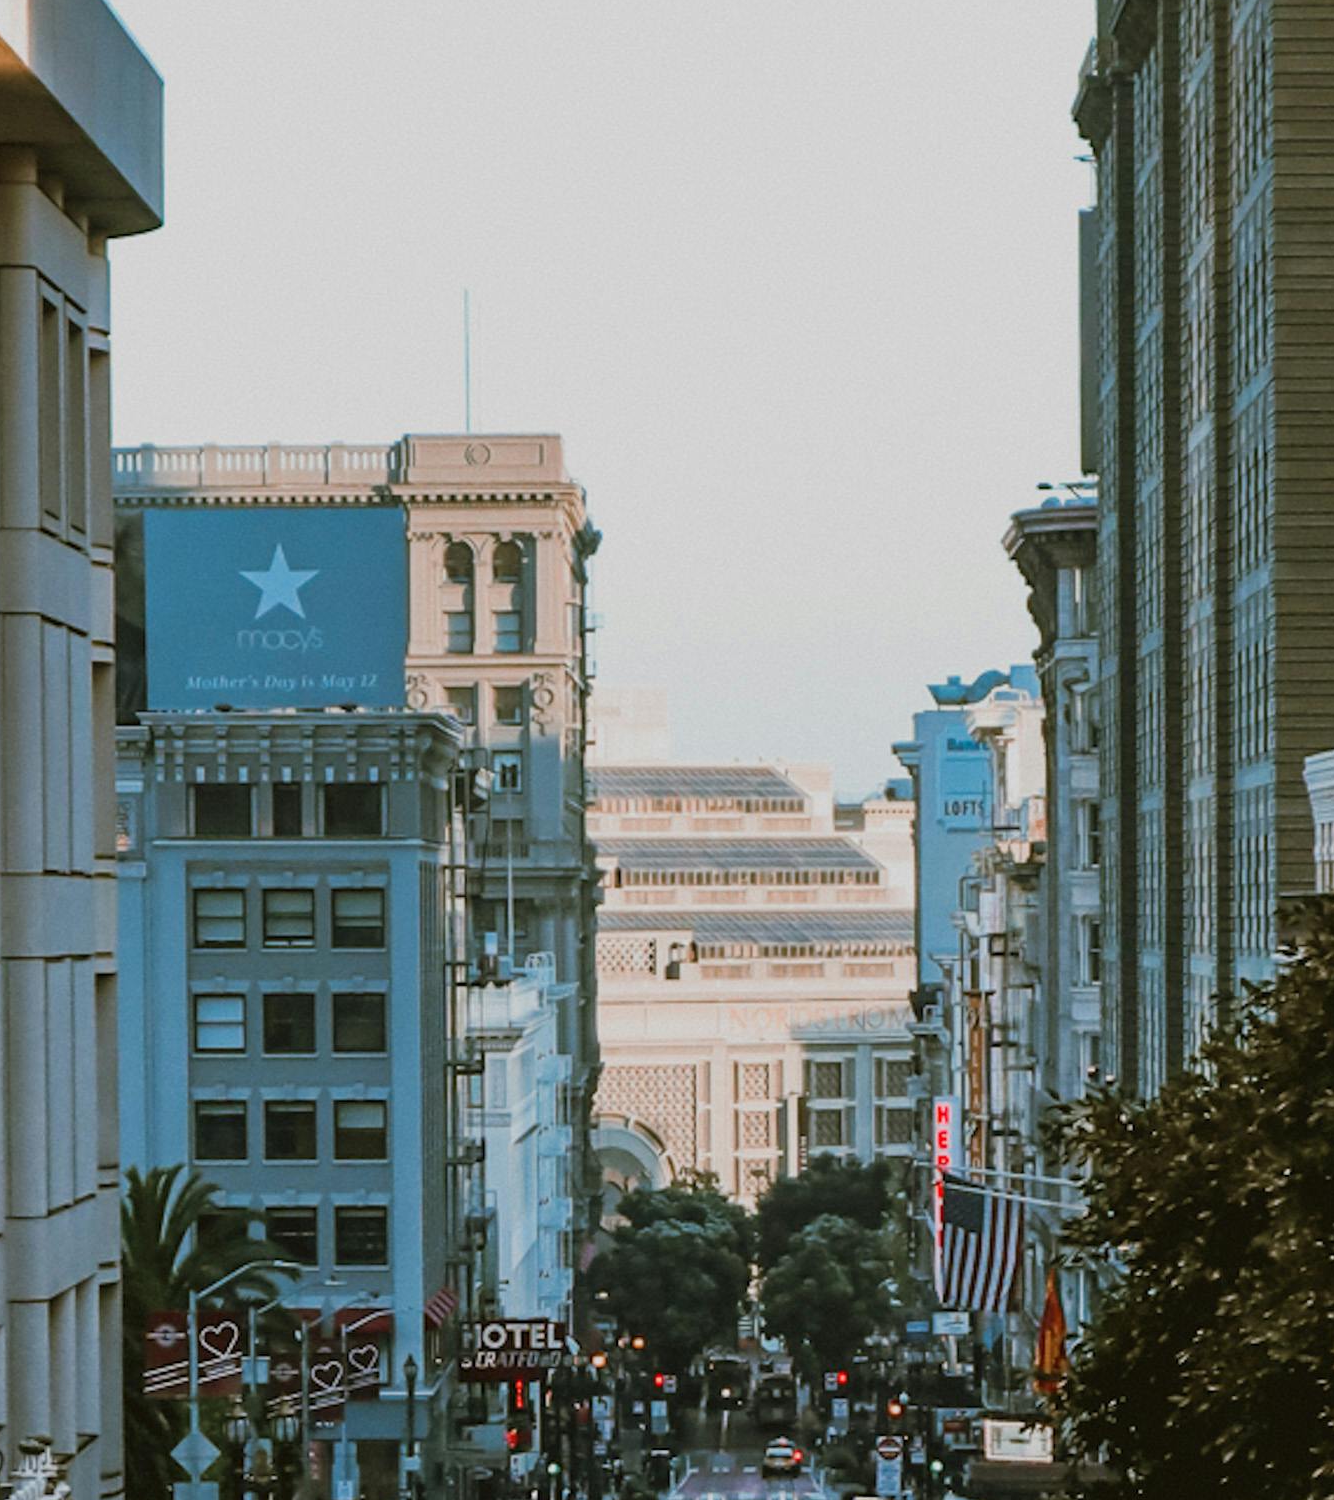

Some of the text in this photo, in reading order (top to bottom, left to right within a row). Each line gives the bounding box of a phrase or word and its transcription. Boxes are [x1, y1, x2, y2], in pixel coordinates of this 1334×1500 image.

[237, 626, 324, 652] macy's
[186, 674, 259, 690] Mother's
[265, 674, 296, 692] Day
[301, 674, 316, 688] is
[321, 674, 357, 692] May
[462, 1322, 564, 1349] HOTEL
